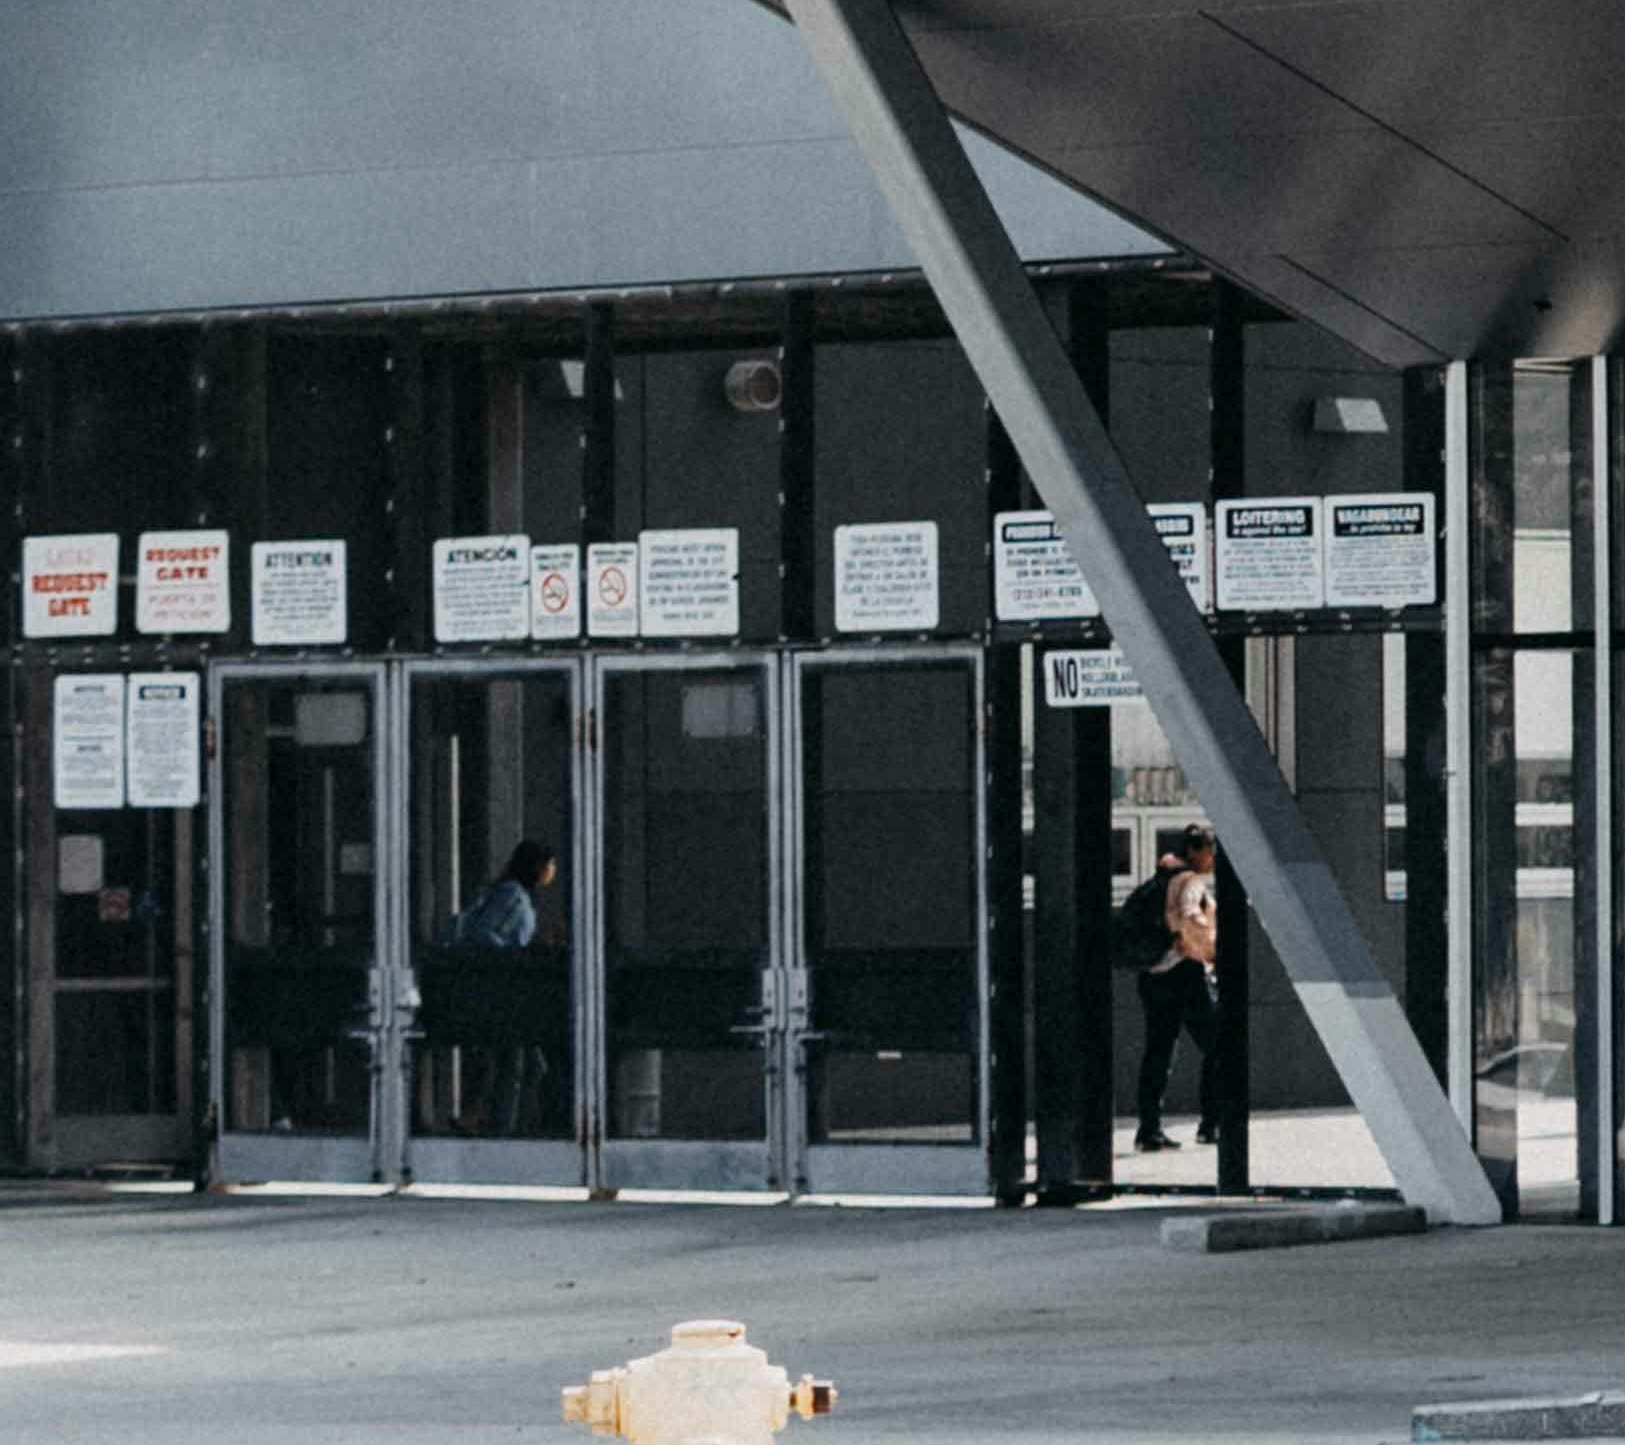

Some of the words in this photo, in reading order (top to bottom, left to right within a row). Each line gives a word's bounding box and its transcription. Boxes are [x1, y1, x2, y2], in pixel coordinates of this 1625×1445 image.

[1232, 508, 1305, 525] LOITERING
[146, 546, 220, 561] REQUEST
[265, 551, 333, 568] ATTENTION
[32, 572, 108, 593] REQUEST
[156, 567, 209, 581] GATE
[48, 598, 91, 617] GATE
[1053, 657, 1078, 699] NO
